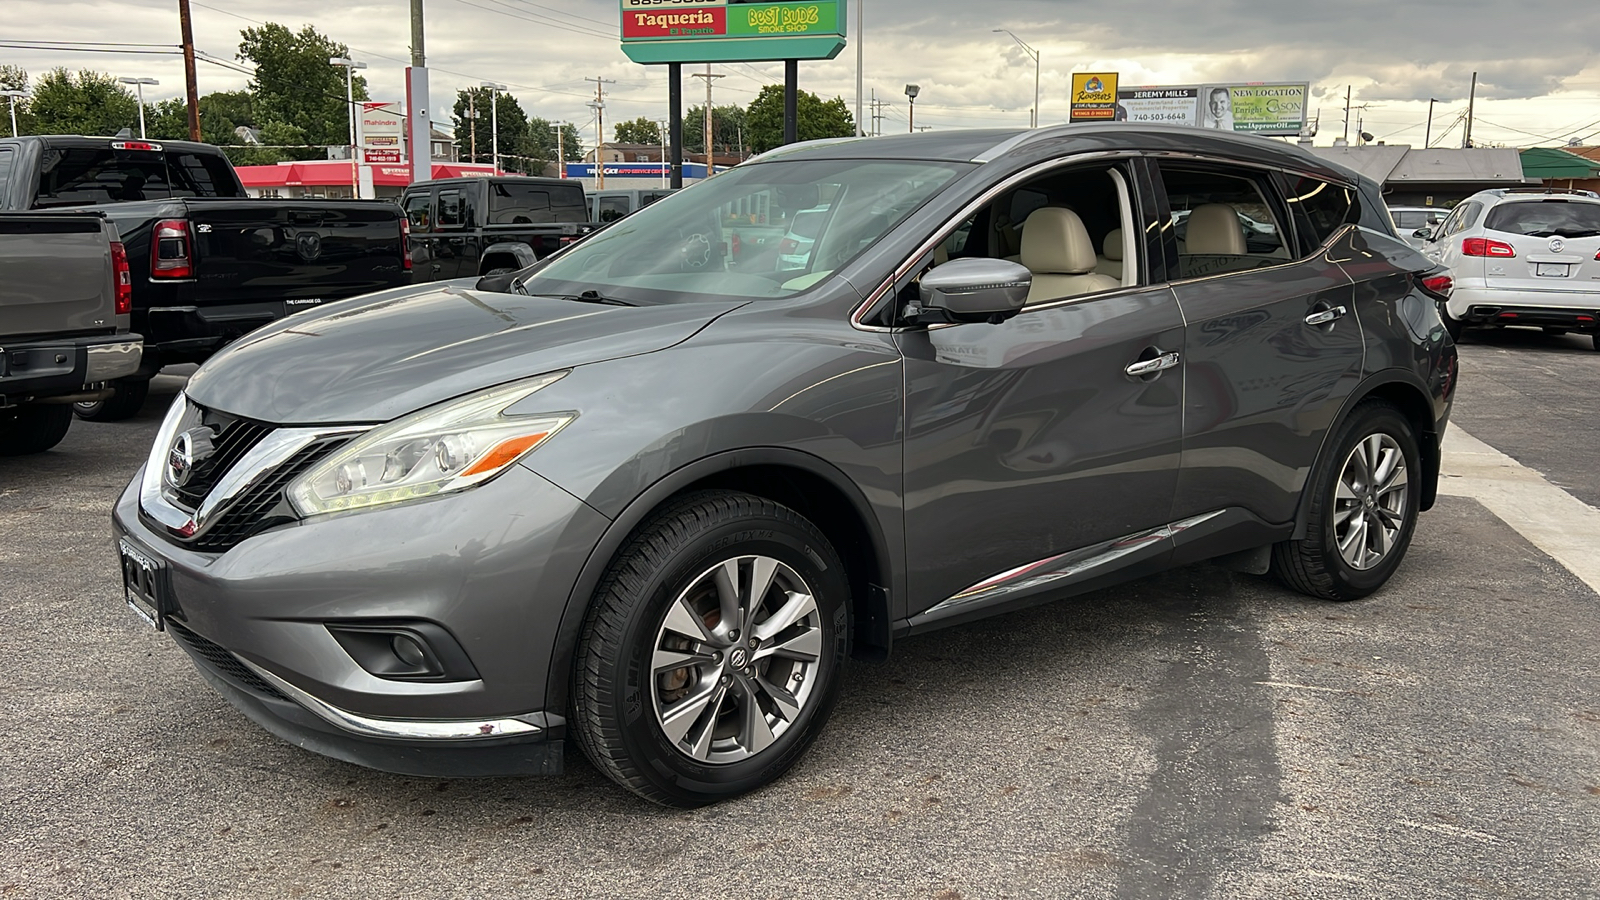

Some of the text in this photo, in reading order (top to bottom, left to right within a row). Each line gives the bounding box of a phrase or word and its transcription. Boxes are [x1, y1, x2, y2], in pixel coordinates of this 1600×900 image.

[758, 24, 808, 34] SMOKE SHOP
[1076, 90, 1112, 102] Roosters
[1133, 89, 1189, 98] JEREMY MILLS
[1233, 88, 1303, 97] NEW LOCATION
[1235, 105, 1263, 115] Enright
[733, 530, 756, 543] LTX
